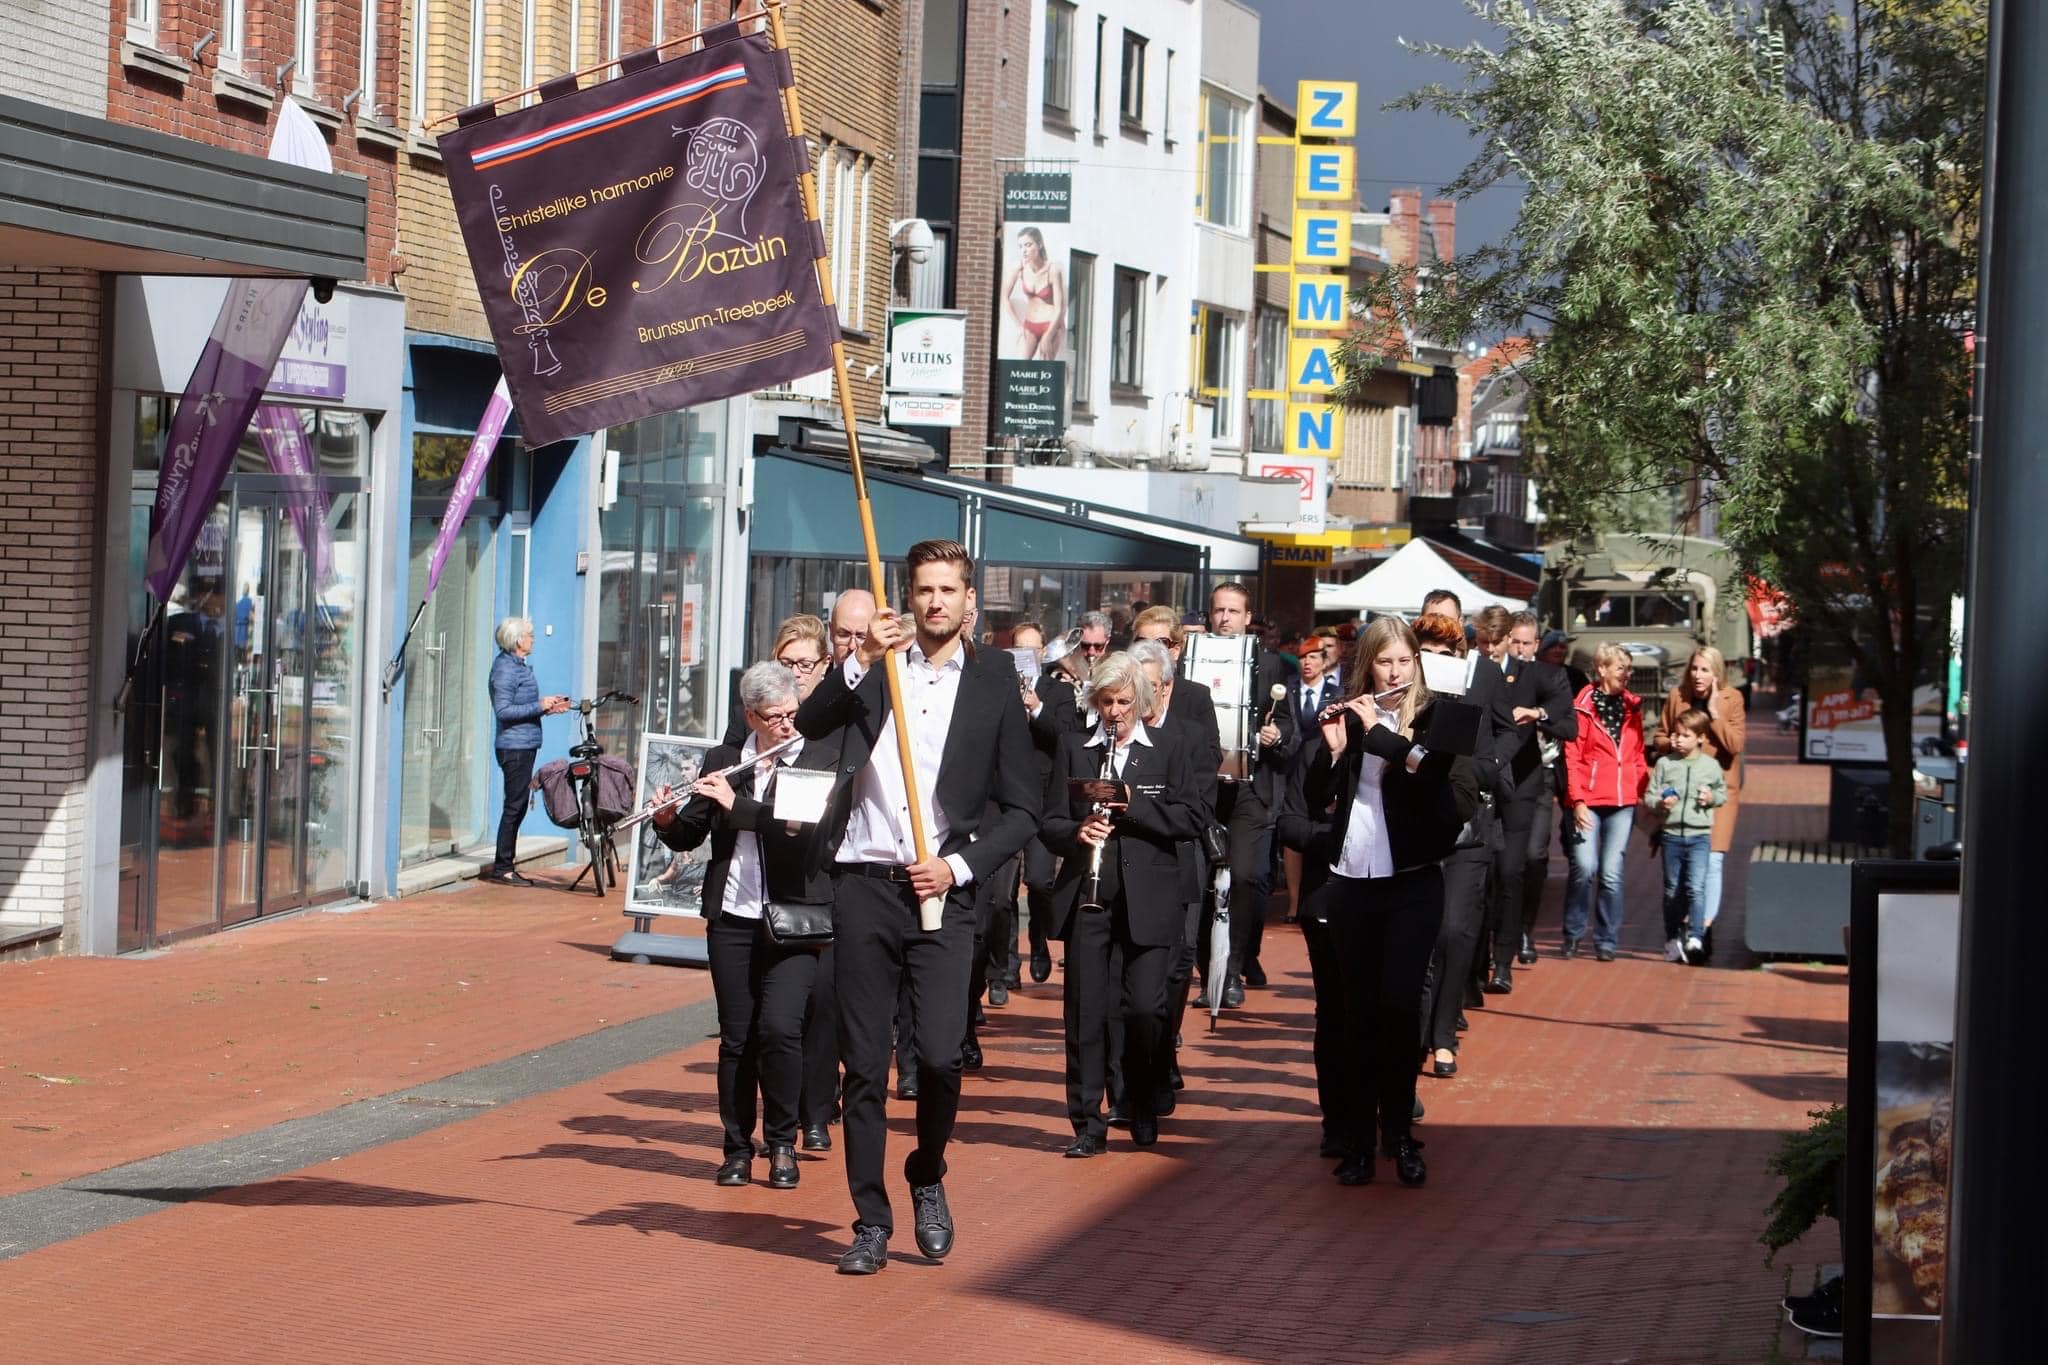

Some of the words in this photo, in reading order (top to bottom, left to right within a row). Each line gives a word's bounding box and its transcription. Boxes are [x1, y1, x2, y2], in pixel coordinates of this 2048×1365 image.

[497, 195, 587, 232] Christelijke
[590, 164, 675, 204] harmonie
[1006, 189, 1068, 201] JOCELYNE
[511, 247, 608, 335] De
[631, 199, 787, 294] Bazuin
[1297, 91, 1344, 449] ZEEMAN
[638, 289, 797, 344] Brunssum-Treebeek
[901, 351, 953, 366] VELTINS
[1274, 546, 1327, 562] EMAN
